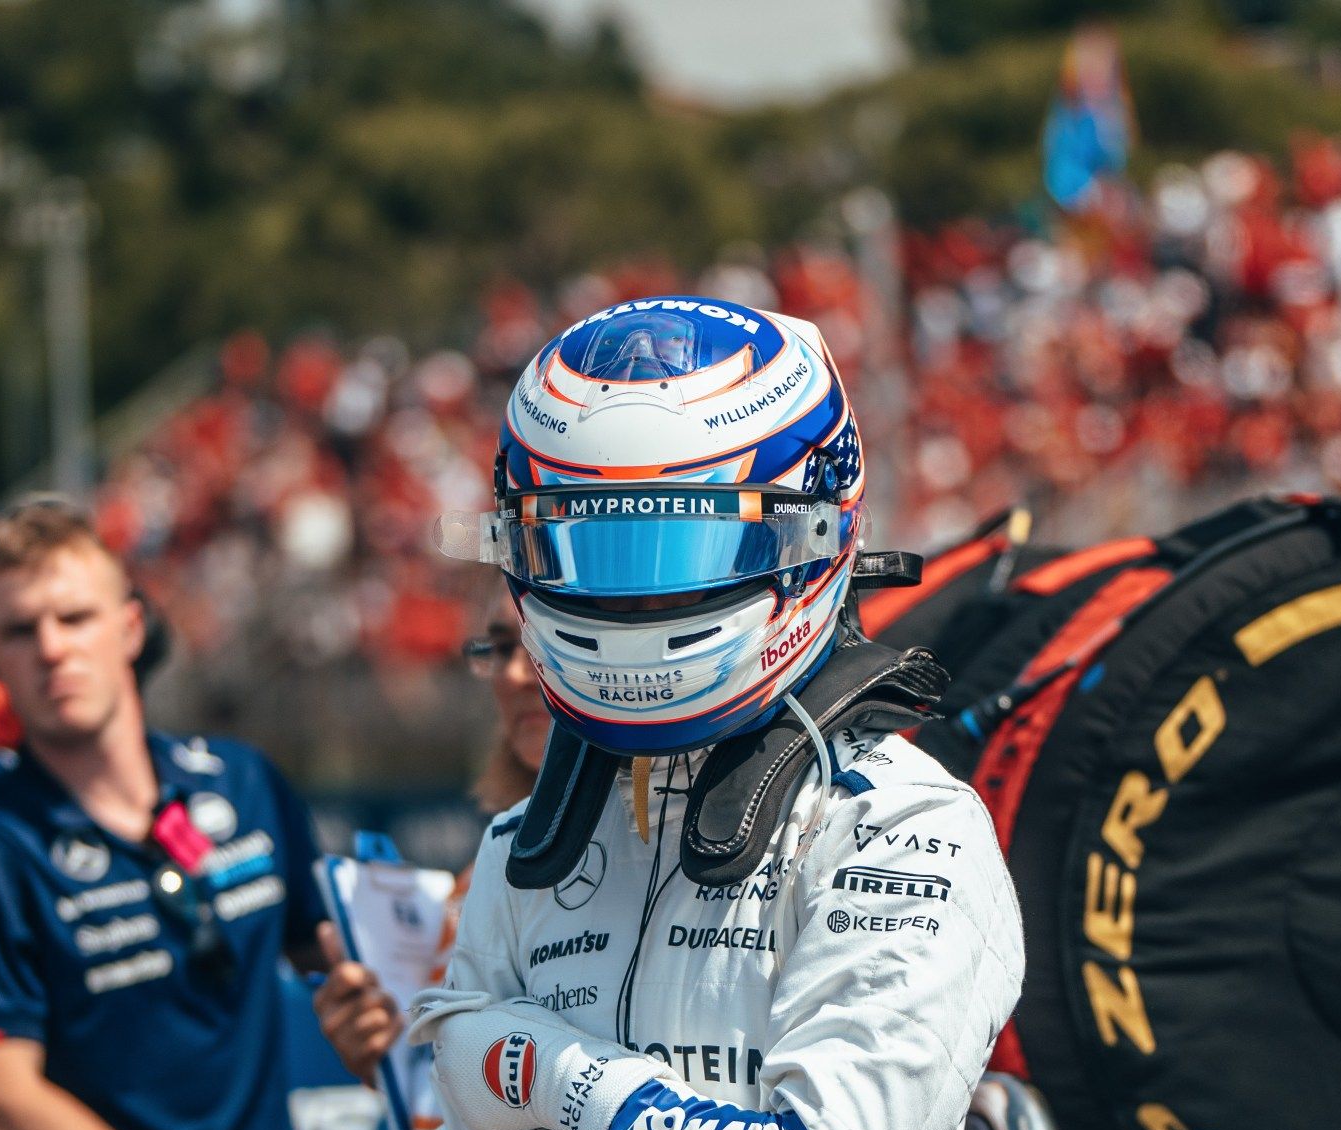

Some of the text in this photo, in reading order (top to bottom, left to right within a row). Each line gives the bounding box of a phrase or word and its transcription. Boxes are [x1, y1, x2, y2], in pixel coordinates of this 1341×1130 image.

[703, 362, 809, 430] WILLIAMS RACING
[530, 404, 568, 434] RACING
[570, 497, 716, 516] MYPROTEIN
[760, 619, 812, 672] ibotta
[598, 688, 675, 702] RACING
[885, 833, 962, 858] VAST
[1083, 674, 1227, 1055] ZERO
[695, 880, 778, 902] RACING
[831, 865, 952, 902] PIRELLI
[667, 924, 777, 952] DURACELL
[853, 915, 940, 936] KEEPER
[529, 929, 610, 969] KOMATSU
[505, 1032, 529, 1107] Gulf
